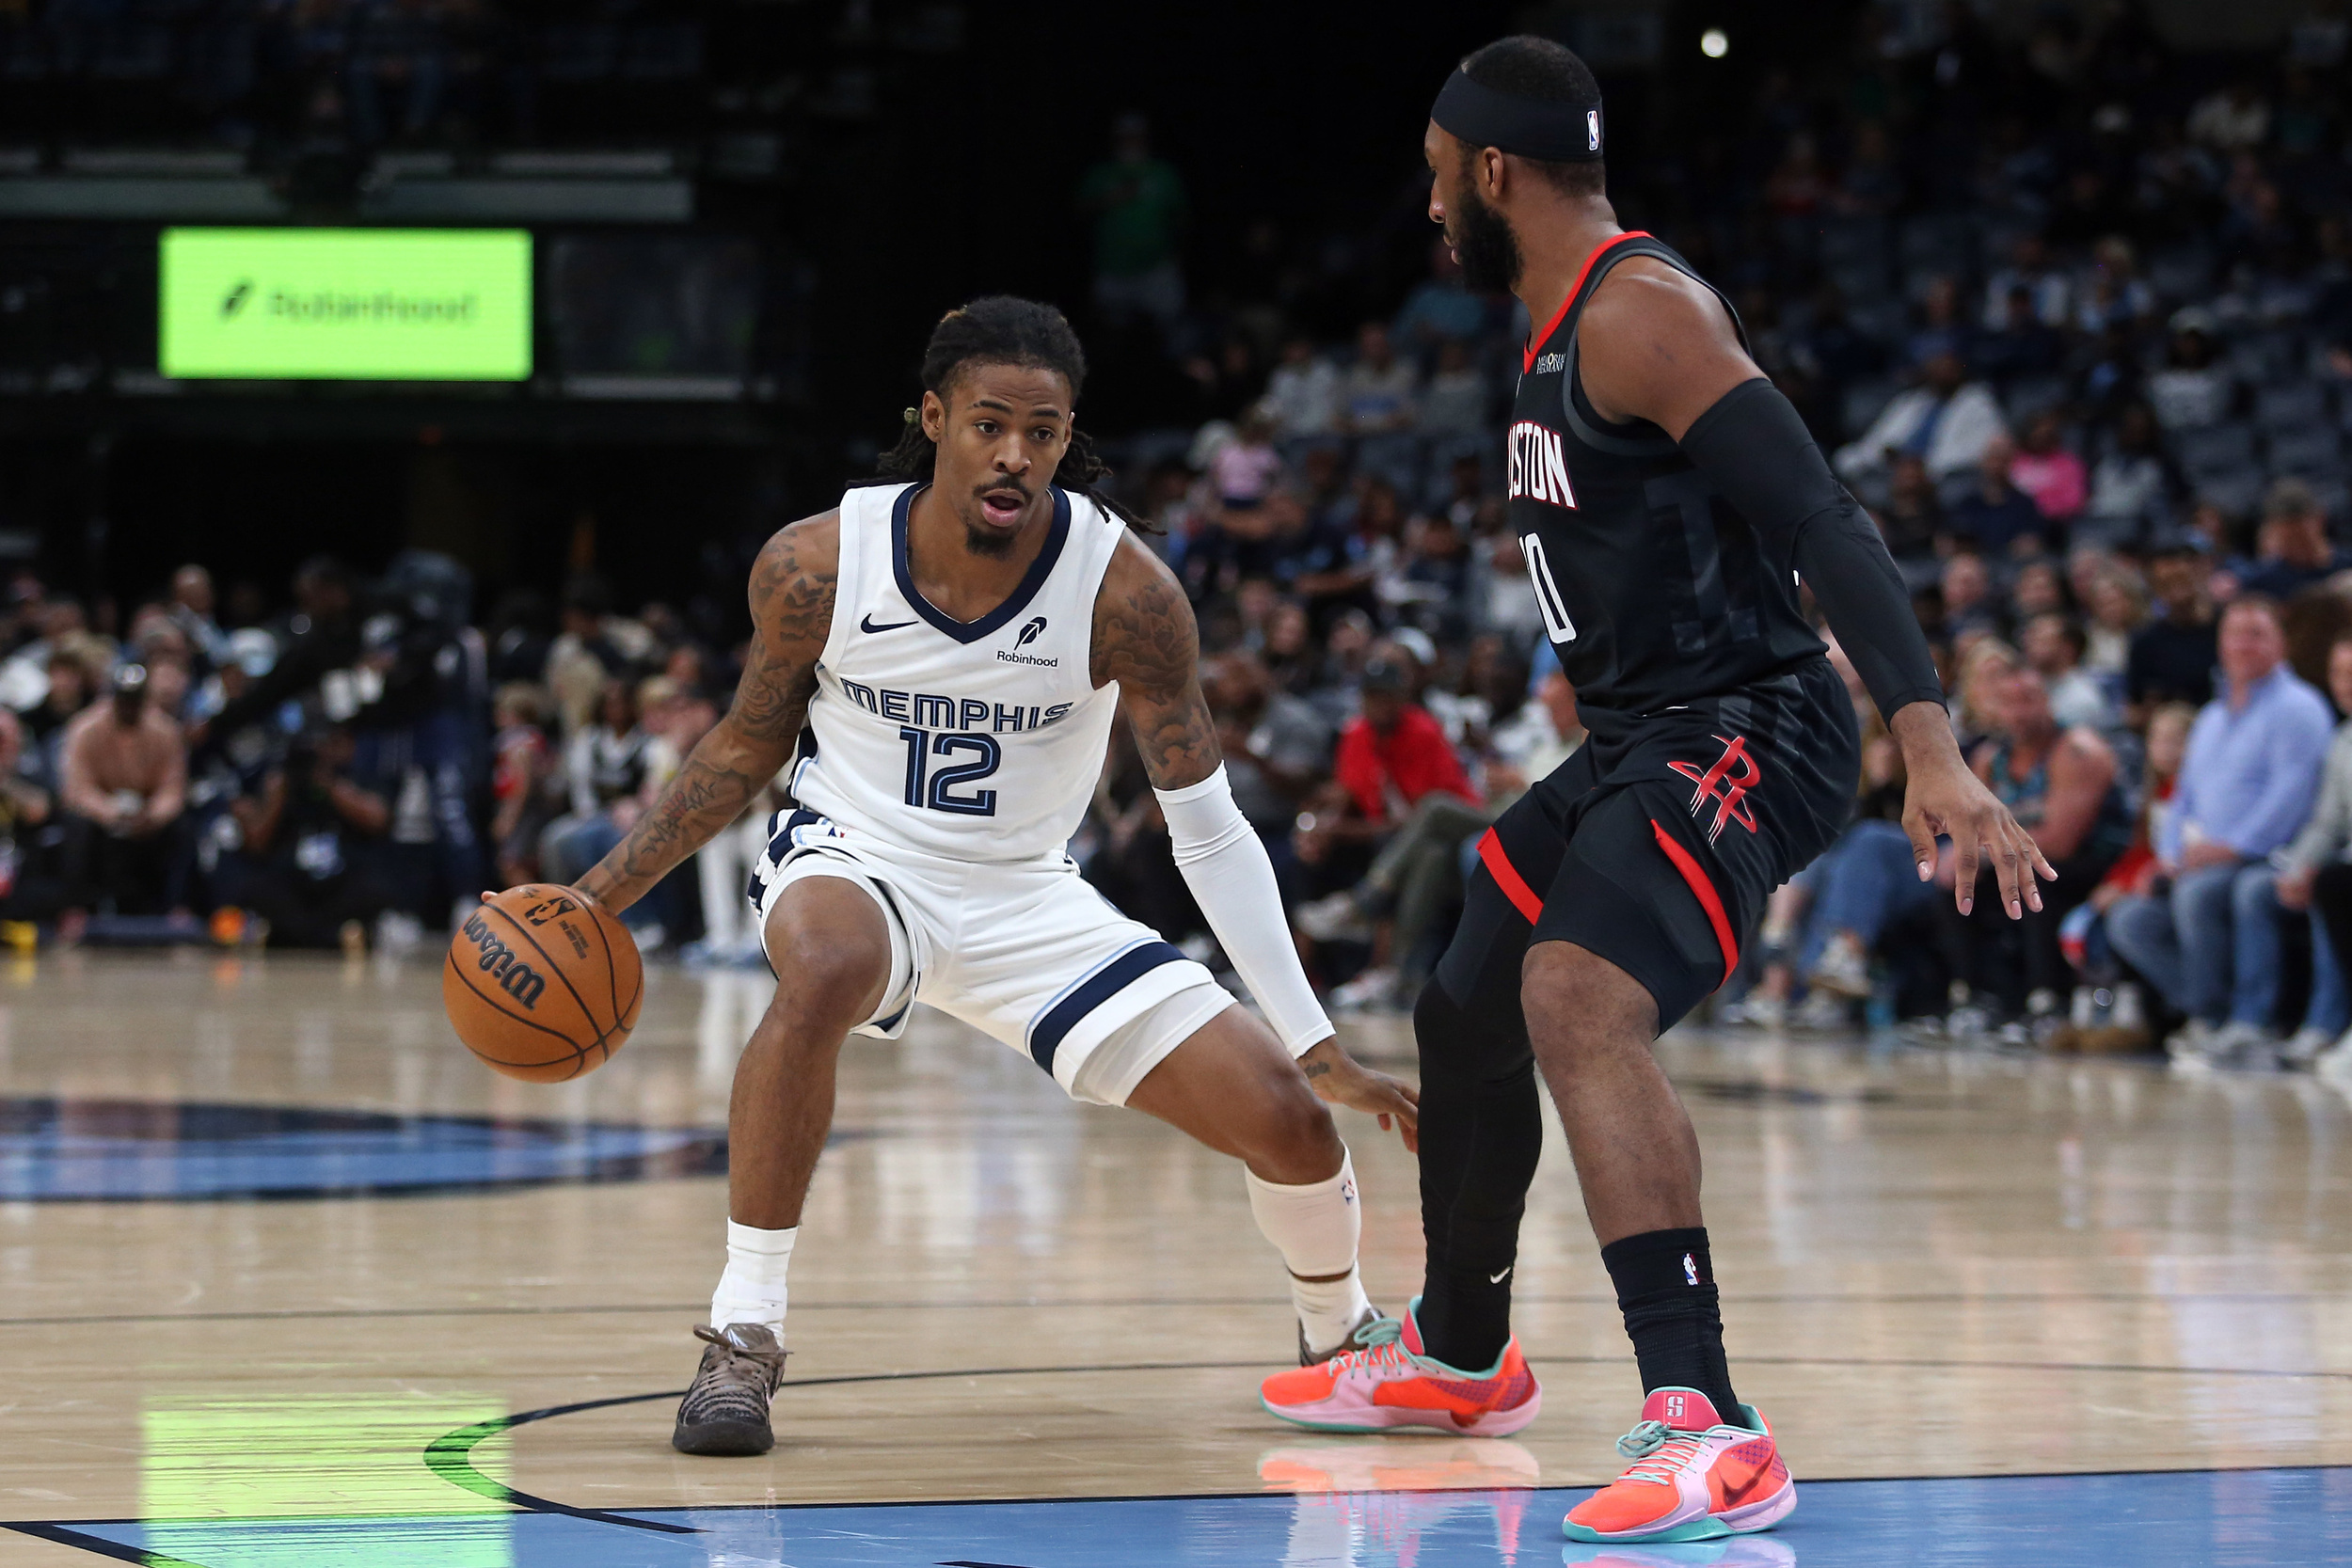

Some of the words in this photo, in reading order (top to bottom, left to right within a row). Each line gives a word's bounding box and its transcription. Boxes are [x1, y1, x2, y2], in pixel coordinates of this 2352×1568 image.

[1507, 420, 1580, 510] USTON
[1518, 532, 1577, 644] 0
[997, 650, 1058, 668] Robinhood
[839, 677, 1074, 733] MEMPHIS
[899, 724, 1001, 816] 12
[463, 911, 545, 1011] Wilson
